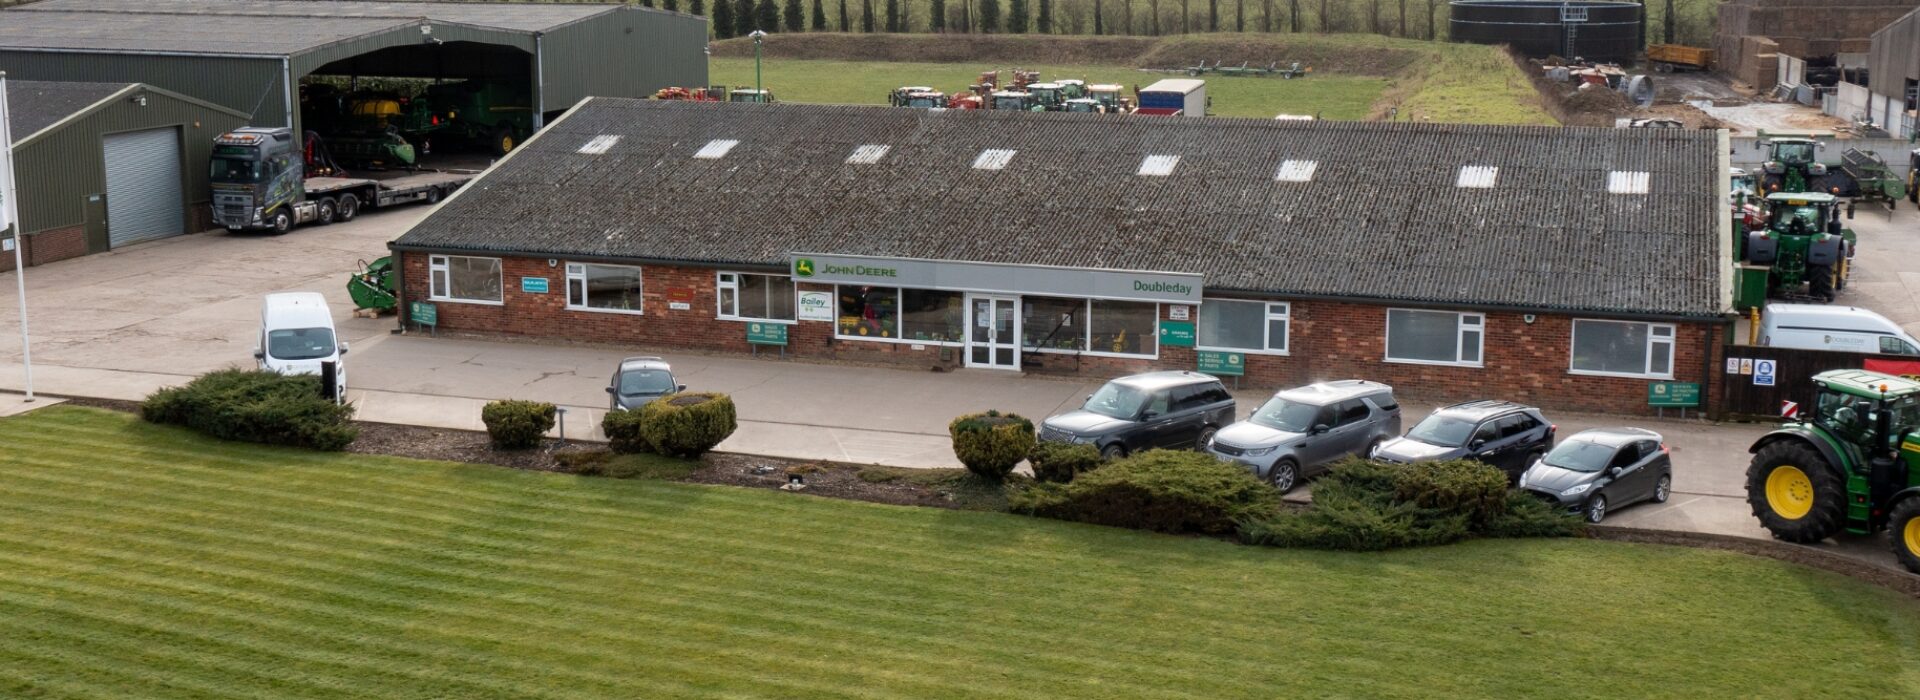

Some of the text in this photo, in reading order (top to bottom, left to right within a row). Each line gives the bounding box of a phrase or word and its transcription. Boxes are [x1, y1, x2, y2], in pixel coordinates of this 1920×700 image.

[821, 263, 897, 278] JOHN DEERE
[1133, 280, 1192, 296] Doubleday
[800, 297, 826, 308] Bailey
